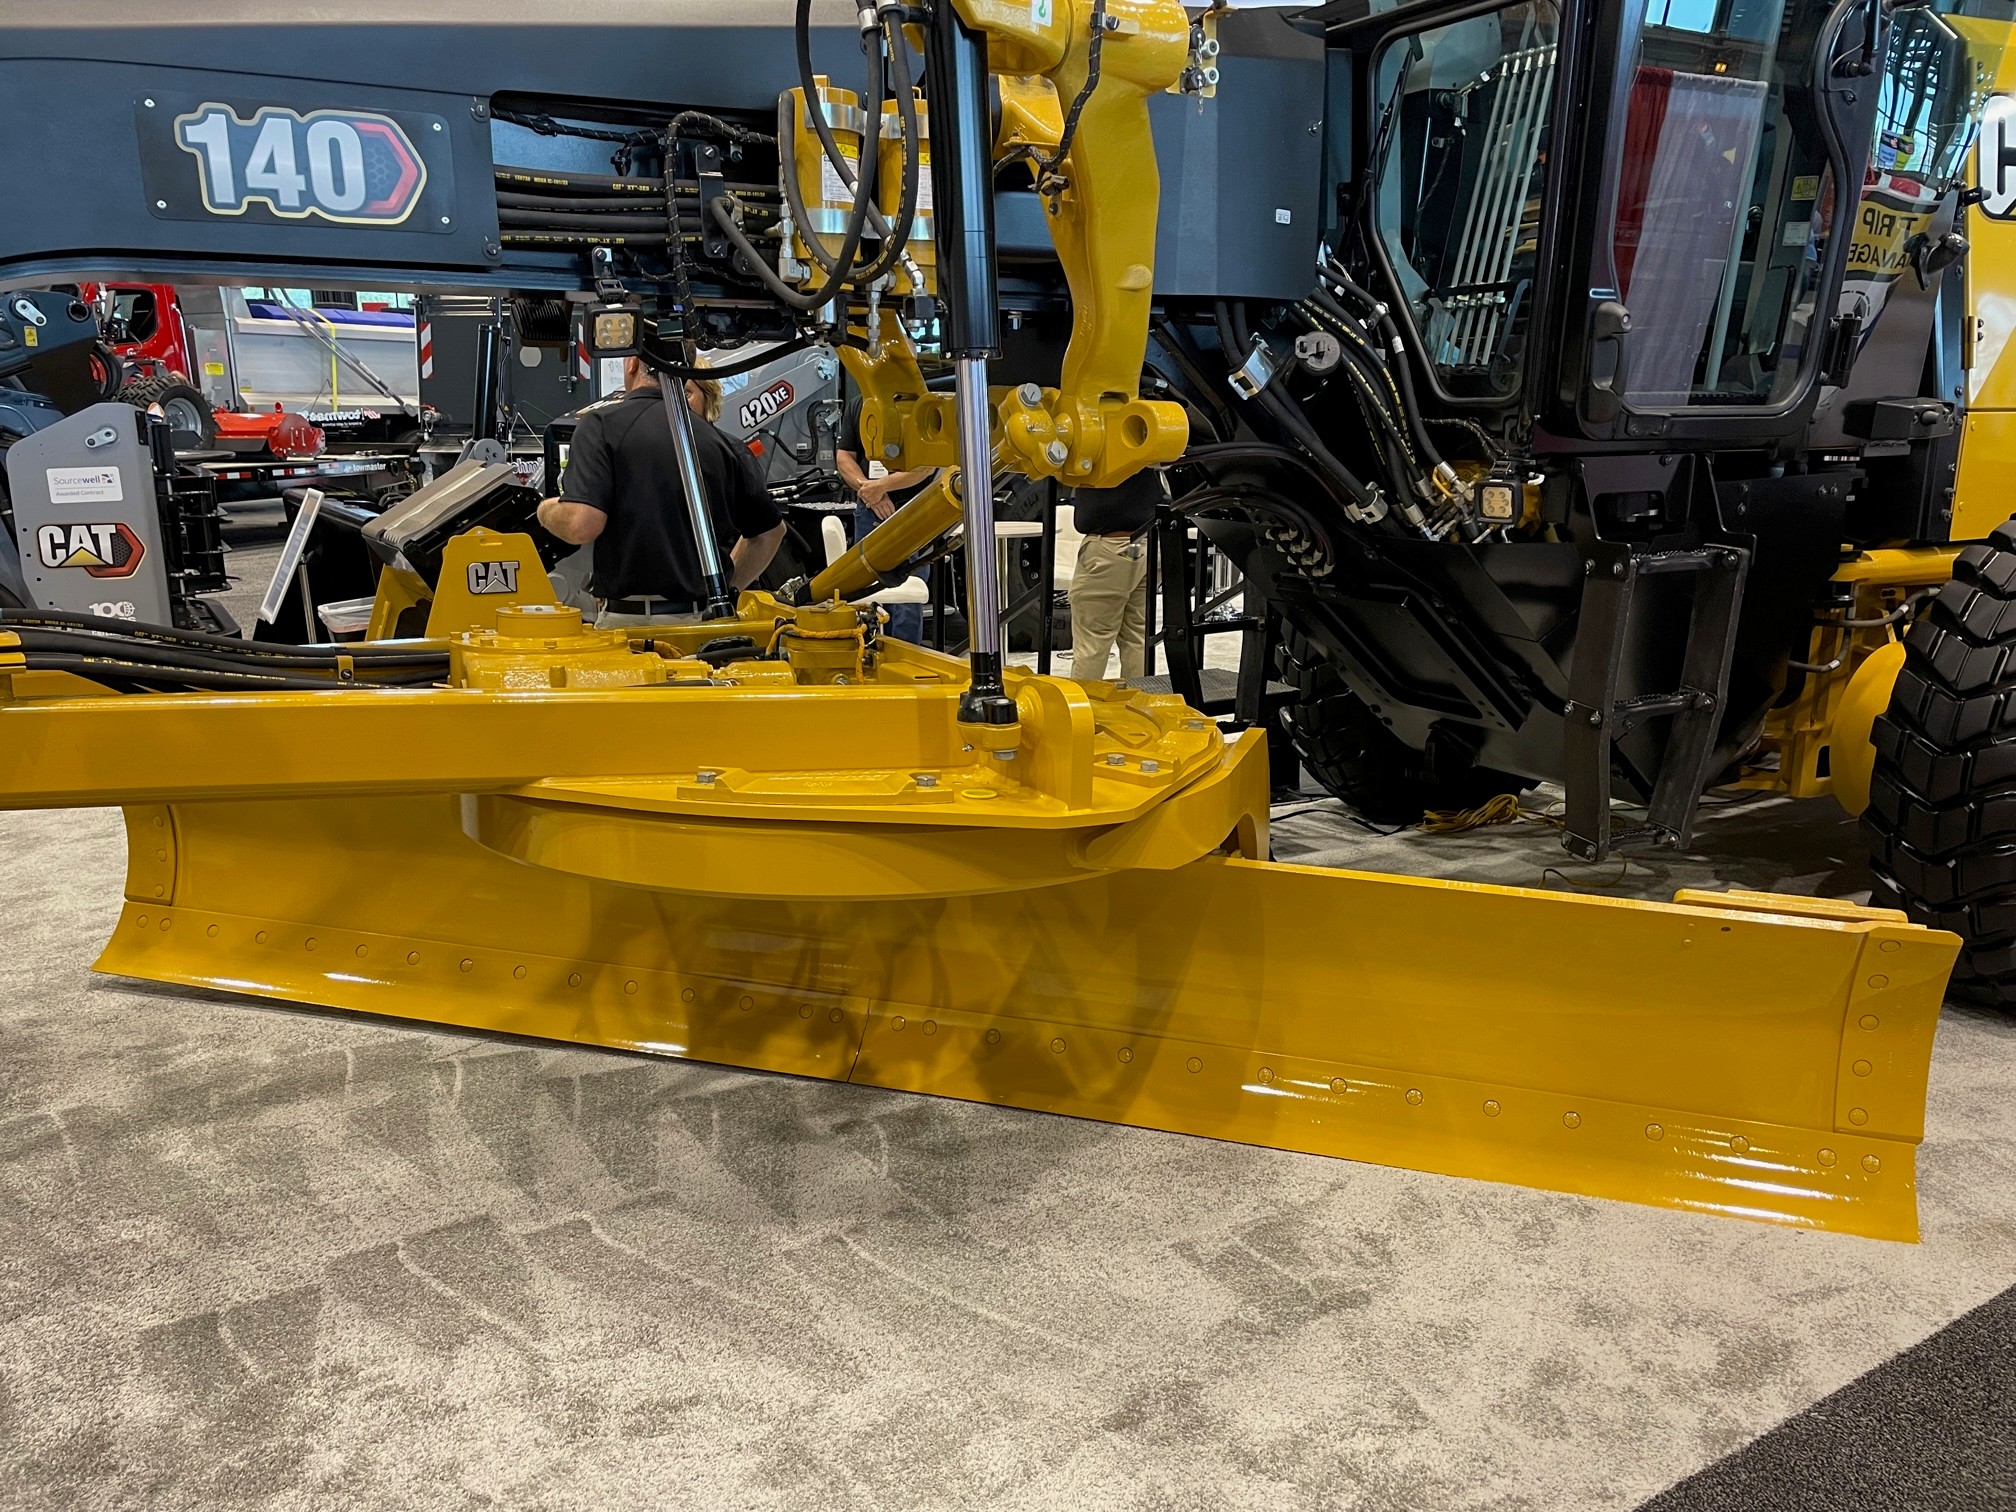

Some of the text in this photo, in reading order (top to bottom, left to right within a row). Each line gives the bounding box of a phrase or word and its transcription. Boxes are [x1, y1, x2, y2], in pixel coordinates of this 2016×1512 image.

[185, 113, 366, 211] 140
[53, 475, 101, 485] Sourcewell
[353, 462, 387, 472] towmaster
[38, 523, 117, 568] CAT
[467, 561, 520, 595] CAT
